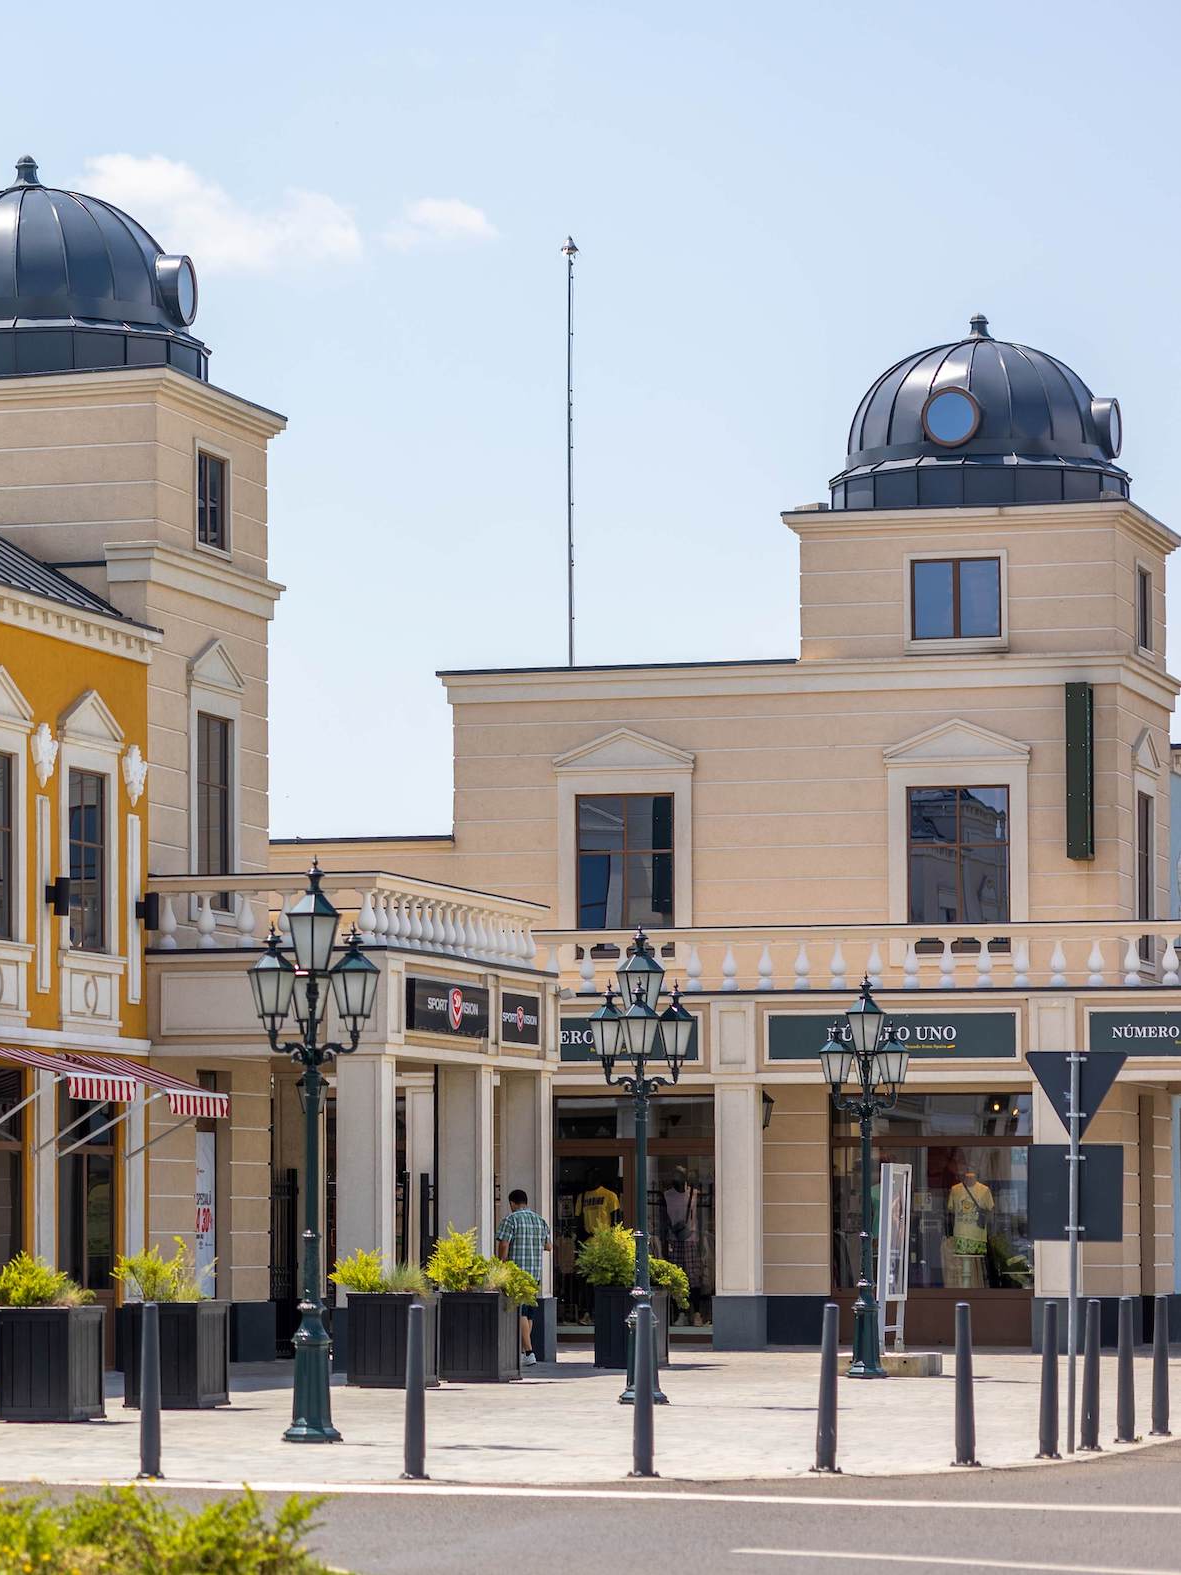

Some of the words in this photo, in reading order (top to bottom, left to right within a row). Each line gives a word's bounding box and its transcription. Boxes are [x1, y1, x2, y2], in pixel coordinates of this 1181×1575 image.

[427, 997, 448, 1012] SPORT
[502, 1012, 518, 1024] SPORT
[523, 1014, 538, 1026] VISION
[915, 1025, 957, 1041] UNO
[1112, 1023, 1180, 1039] NÚMERO
